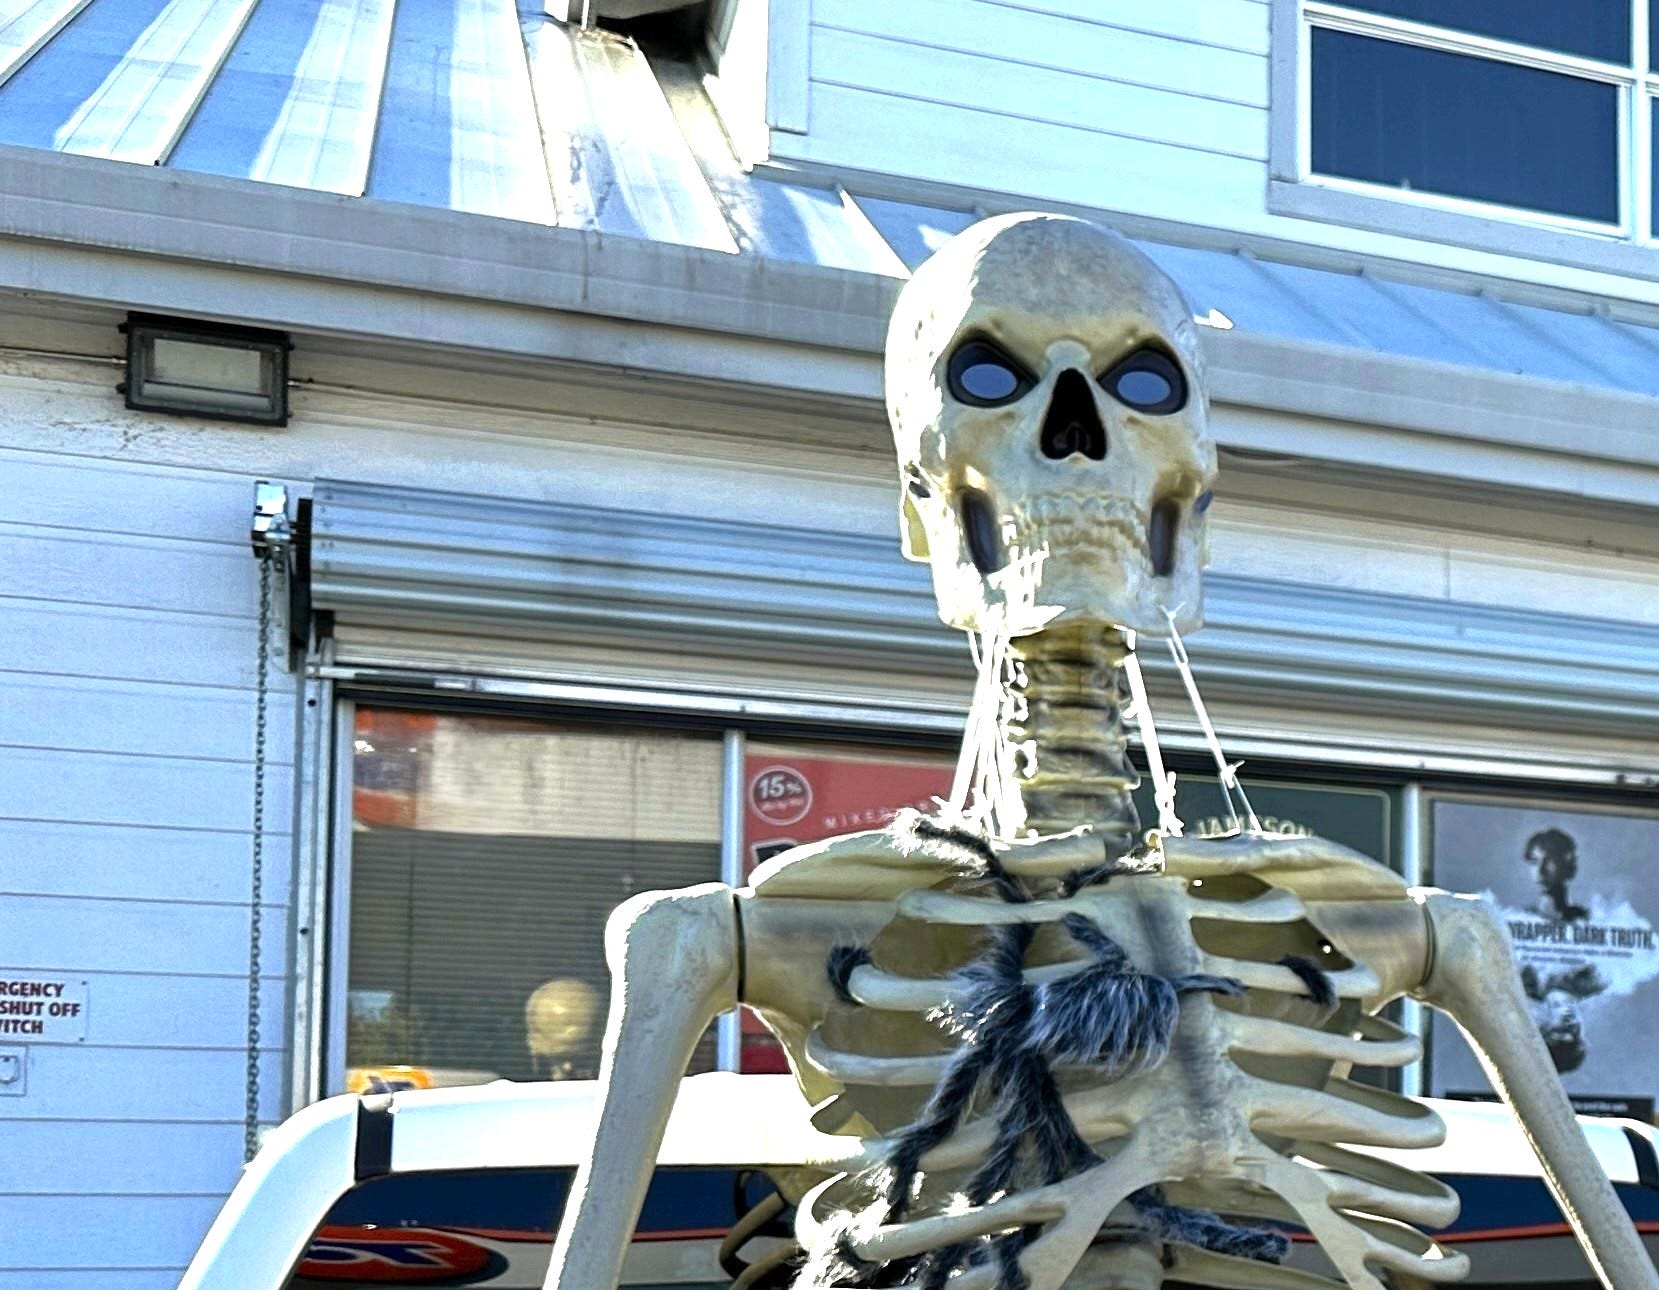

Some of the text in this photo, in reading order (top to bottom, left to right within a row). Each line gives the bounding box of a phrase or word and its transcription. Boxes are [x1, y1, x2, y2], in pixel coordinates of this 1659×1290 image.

[1574, 926, 1605, 945] DARK
[0, 981, 65, 998] RGENCY
[0, 1000, 80, 1017] SHUT OFF
[0, 1019, 44, 1035] ITCH
